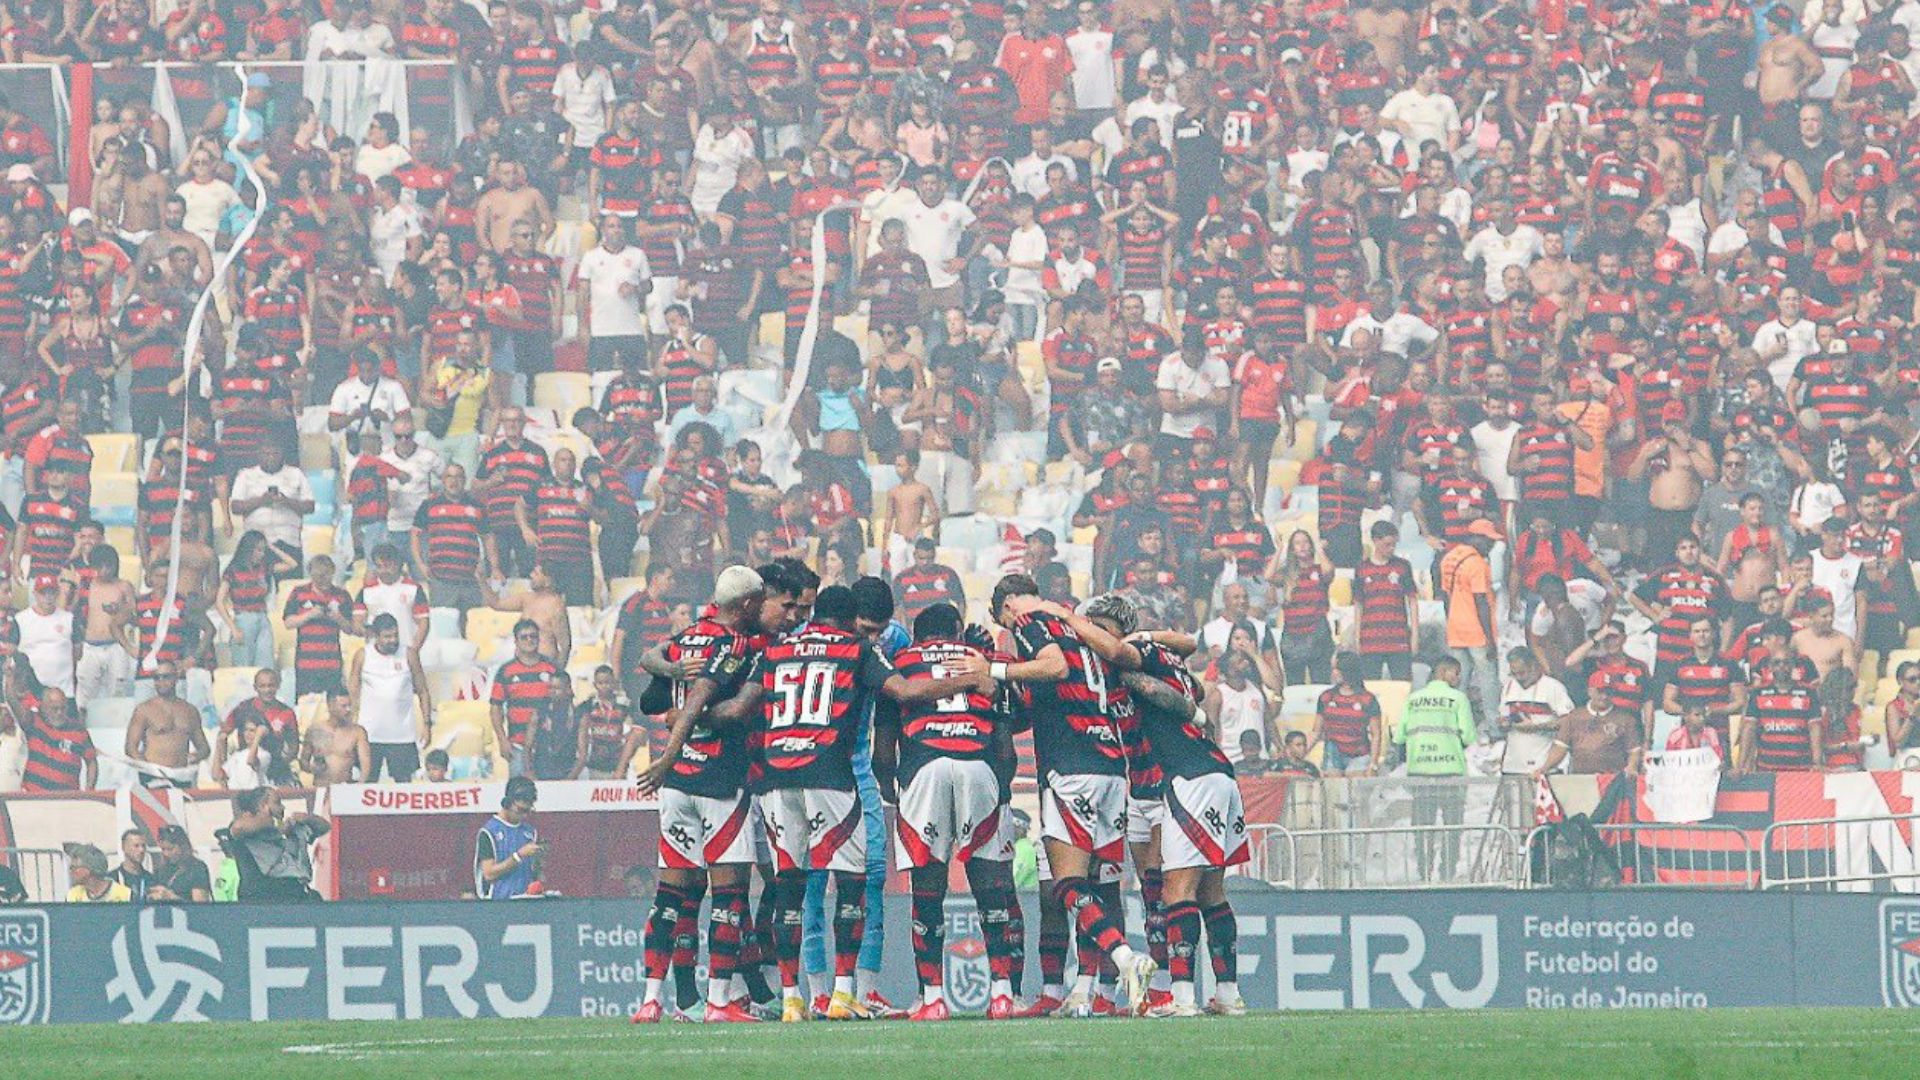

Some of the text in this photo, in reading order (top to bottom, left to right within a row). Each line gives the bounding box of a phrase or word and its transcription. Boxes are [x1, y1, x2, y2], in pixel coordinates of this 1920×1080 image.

[770, 661, 838, 729] 50
[362, 787, 481, 809] SUPERBET
[591, 787, 622, 802] AQUI
[1205, 807, 1226, 835] abc
[668, 824, 696, 850] abc
[1524, 916, 1694, 943] Federação de
[249, 925, 553, 1019] FERJ
[1525, 951, 1658, 973] Futebol do
[581, 997, 620, 1017] Rio
[1526, 986, 1708, 1008] Rio de Janeiro
